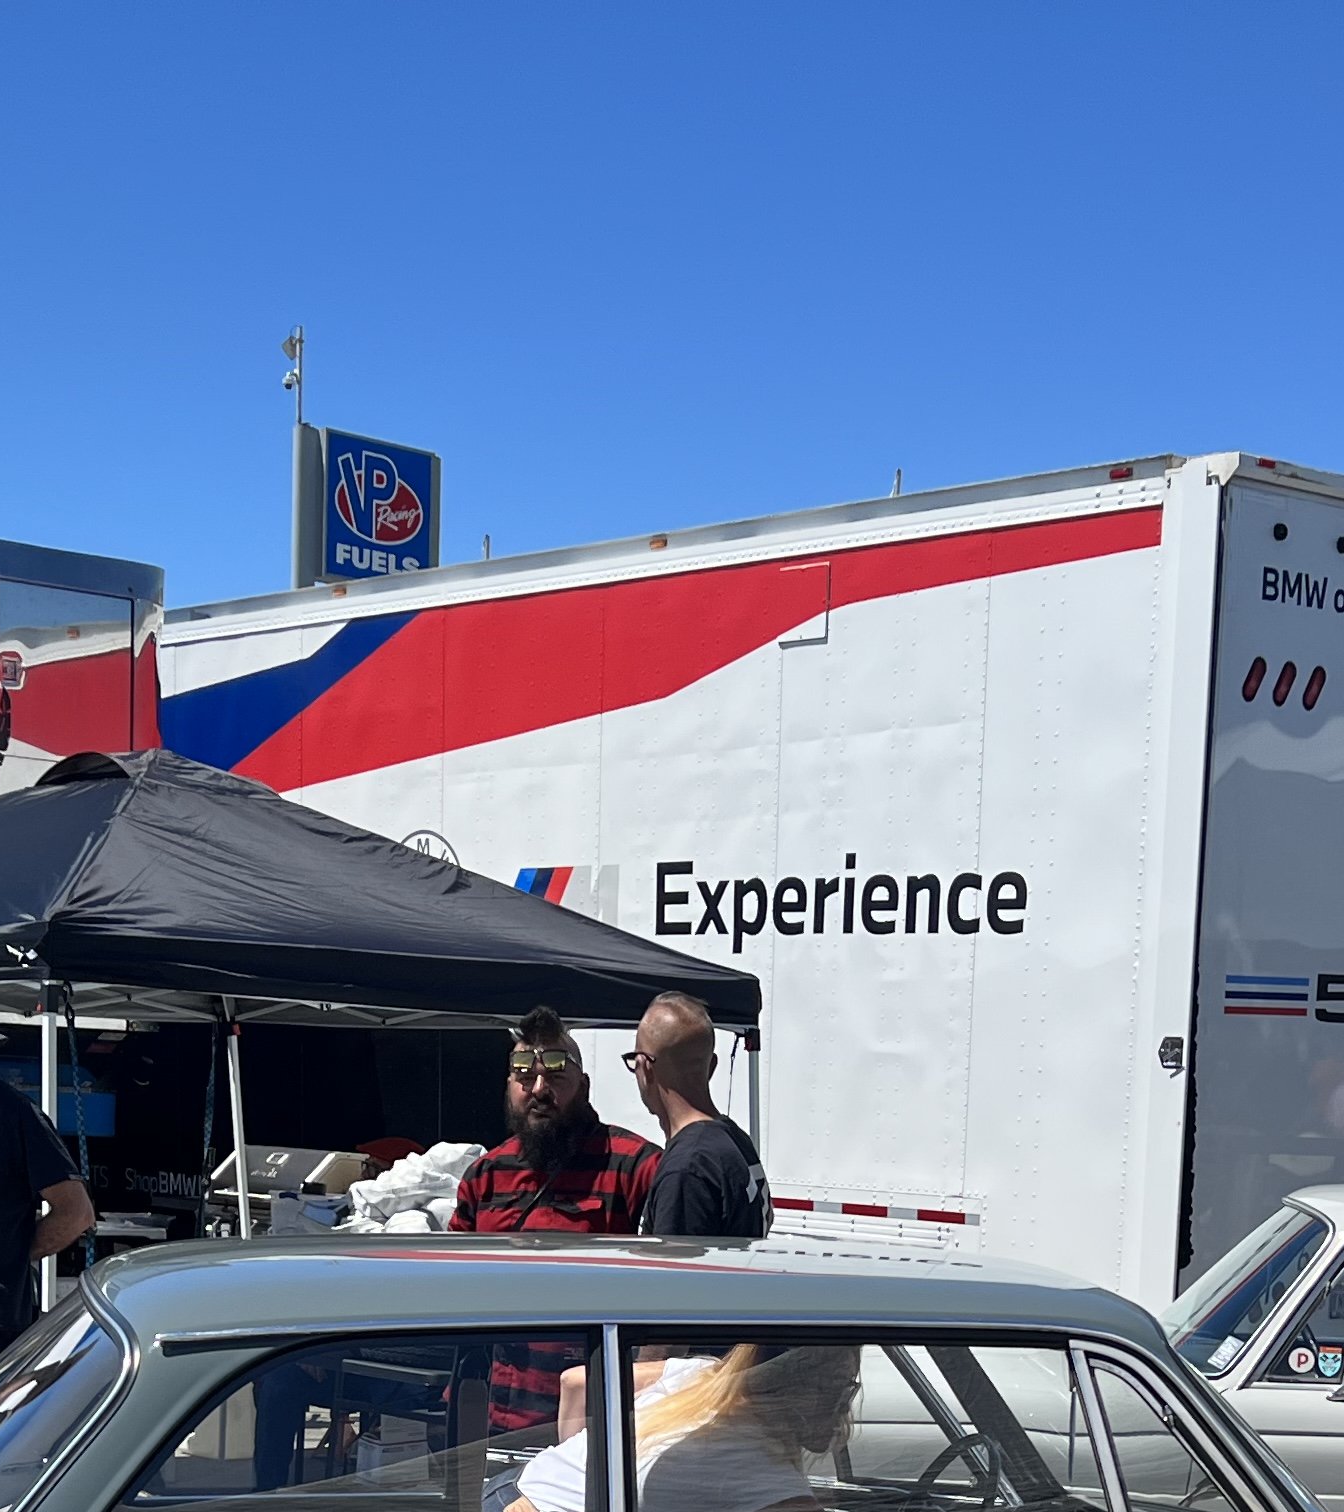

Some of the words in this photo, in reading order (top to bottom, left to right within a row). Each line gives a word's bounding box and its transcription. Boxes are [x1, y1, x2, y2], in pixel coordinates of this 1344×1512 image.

[337, 450, 398, 541] VP
[377, 505, 421, 531] Racing
[336, 543, 420, 575] FUELS
[1261, 566, 1328, 609] BMW
[655, 853, 1028, 954] Experience
